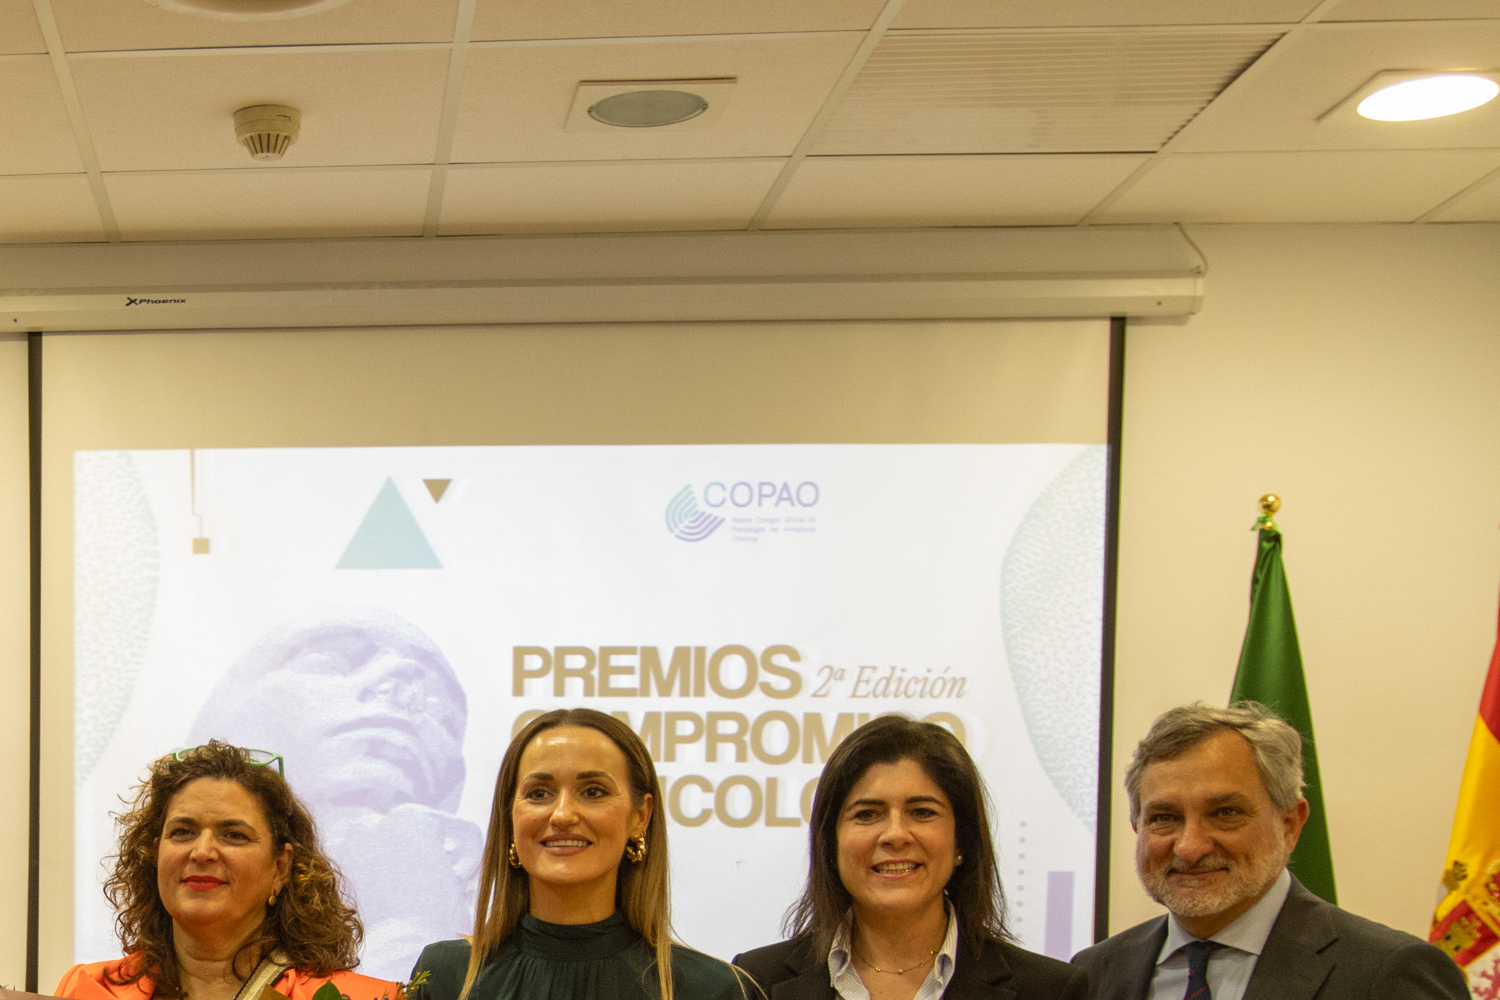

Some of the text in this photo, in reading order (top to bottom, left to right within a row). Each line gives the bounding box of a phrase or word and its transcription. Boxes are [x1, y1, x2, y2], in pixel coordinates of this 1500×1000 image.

[703, 481, 820, 507] COPAO
[511, 644, 967, 699] PREMIOS 2ª Edición
